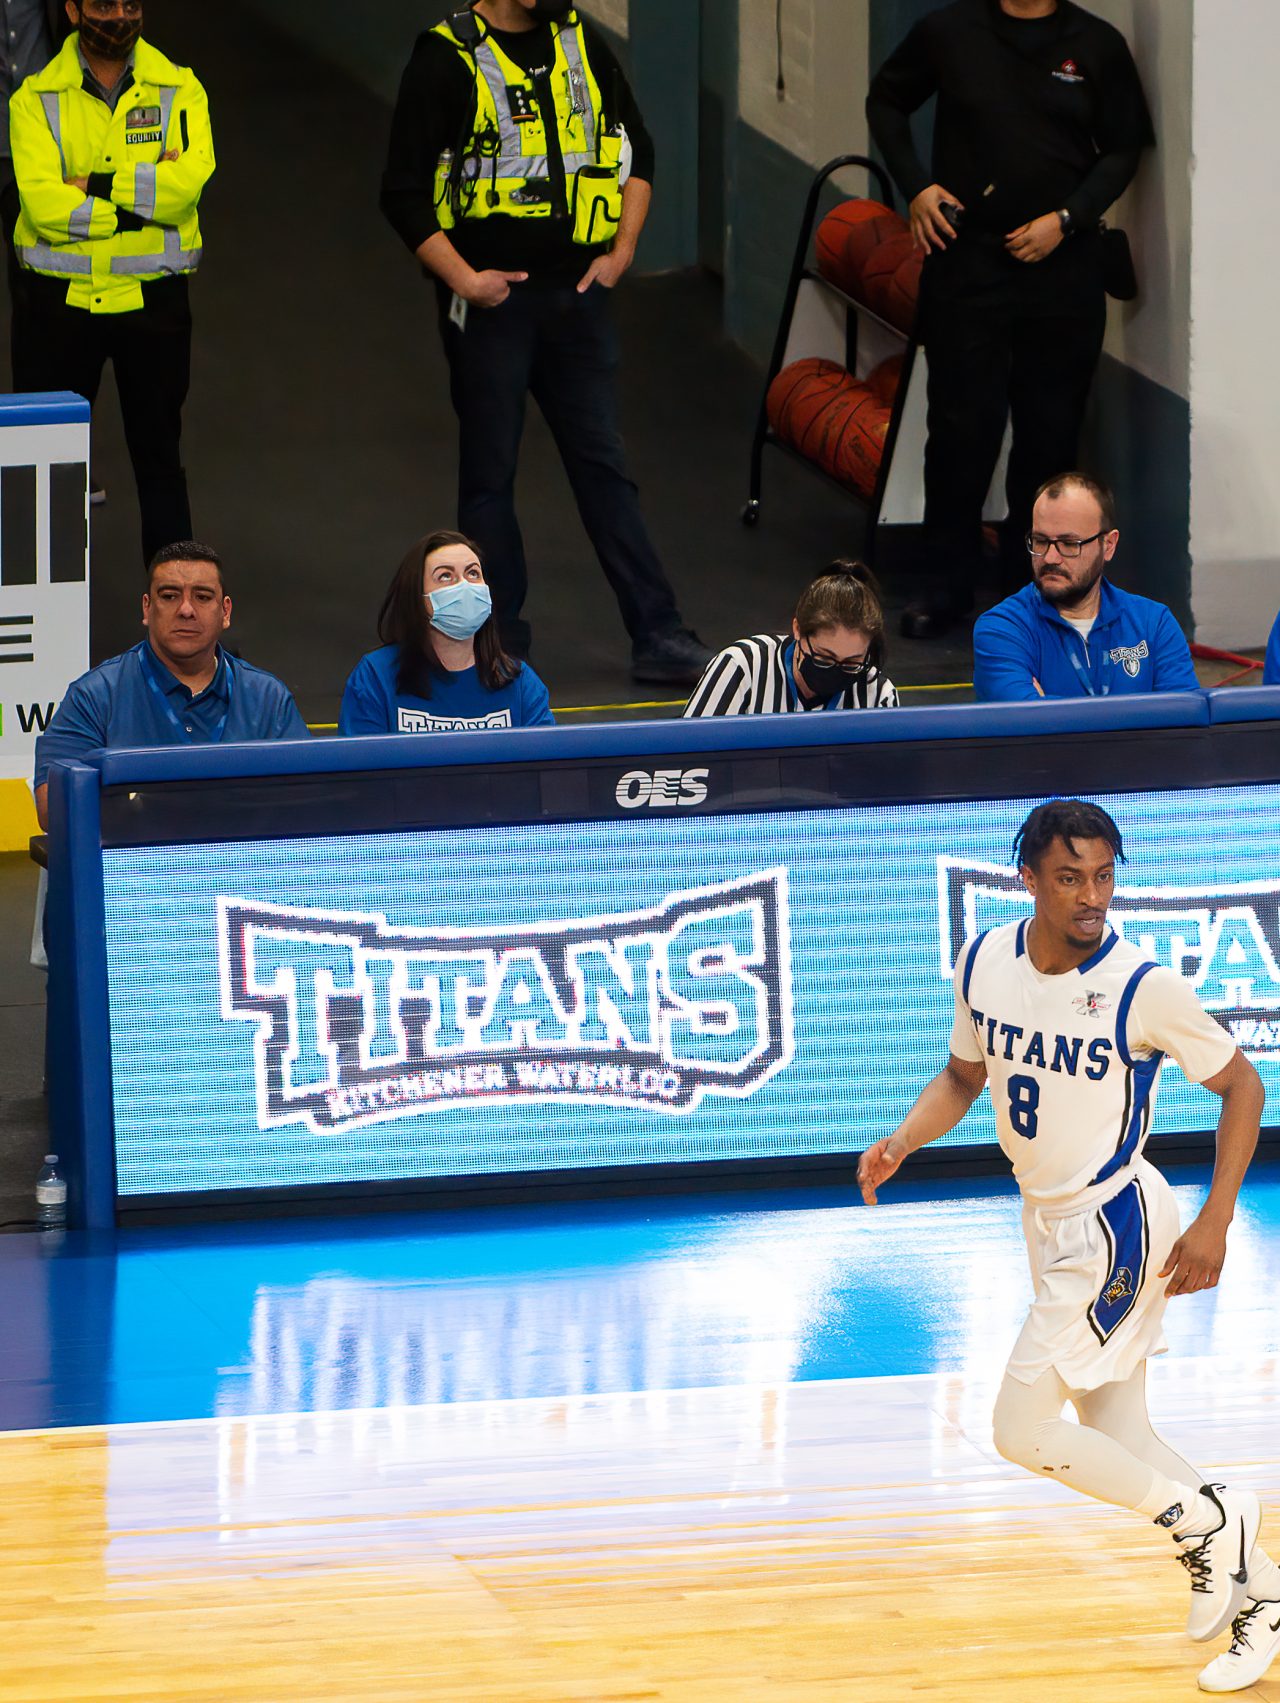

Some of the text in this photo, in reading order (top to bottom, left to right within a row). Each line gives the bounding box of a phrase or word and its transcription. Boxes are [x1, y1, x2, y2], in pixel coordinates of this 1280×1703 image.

[616, 768, 710, 809] OES
[241, 898, 770, 1100] TITANS
[325, 1061, 681, 1119] KITCHENER WATERLOO
[1007, 1073, 1041, 1140] 8
